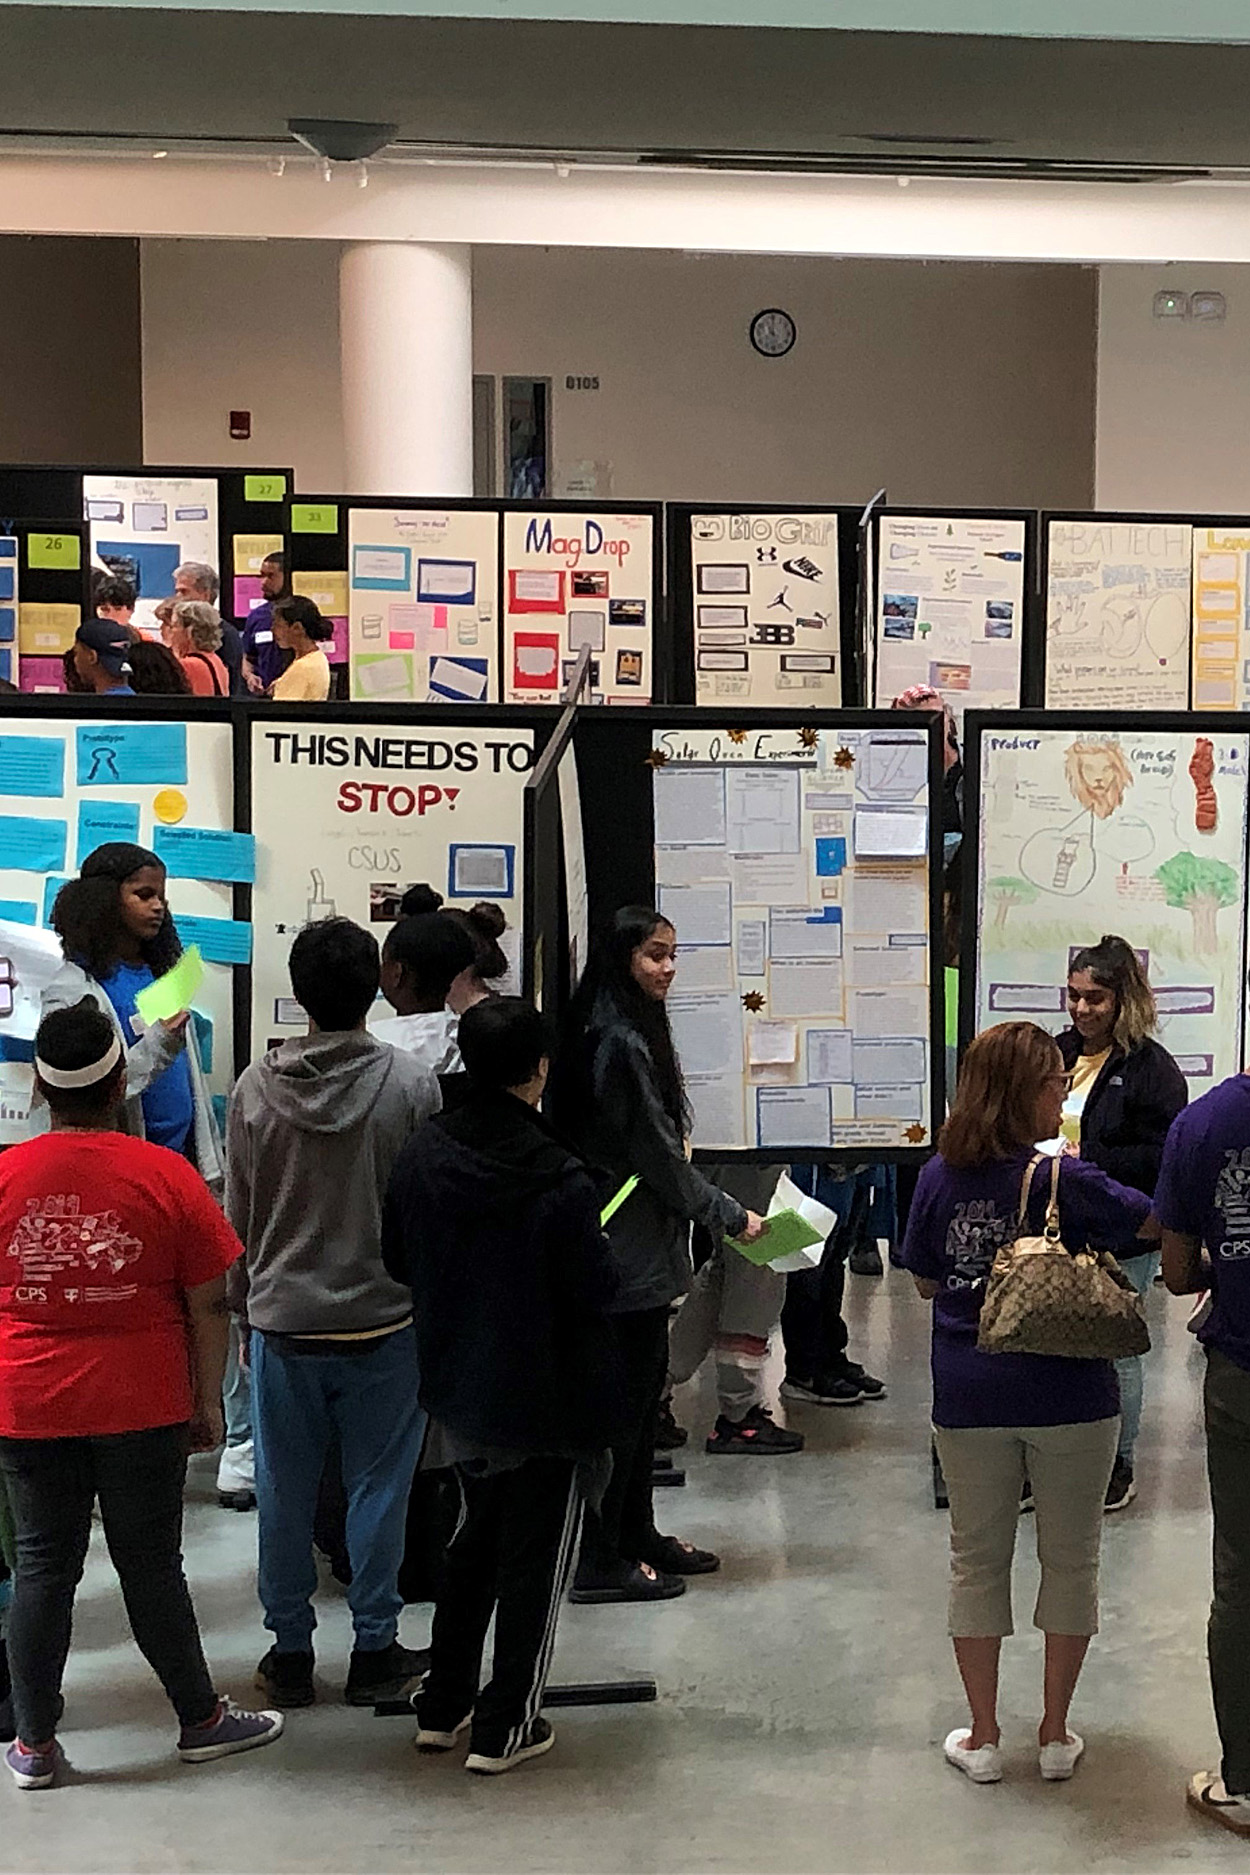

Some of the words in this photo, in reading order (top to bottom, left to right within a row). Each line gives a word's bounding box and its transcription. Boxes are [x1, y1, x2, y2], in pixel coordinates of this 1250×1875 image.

[45, 537, 62, 550] 26
[265, 732, 350, 766] THIS
[354, 736, 478, 772] NEEDS
[485, 742, 536, 773] TO
[710, 737, 744, 761] Oven
[348, 845, 401, 873] CSUS
[16, 1286, 48, 1301] CPS
